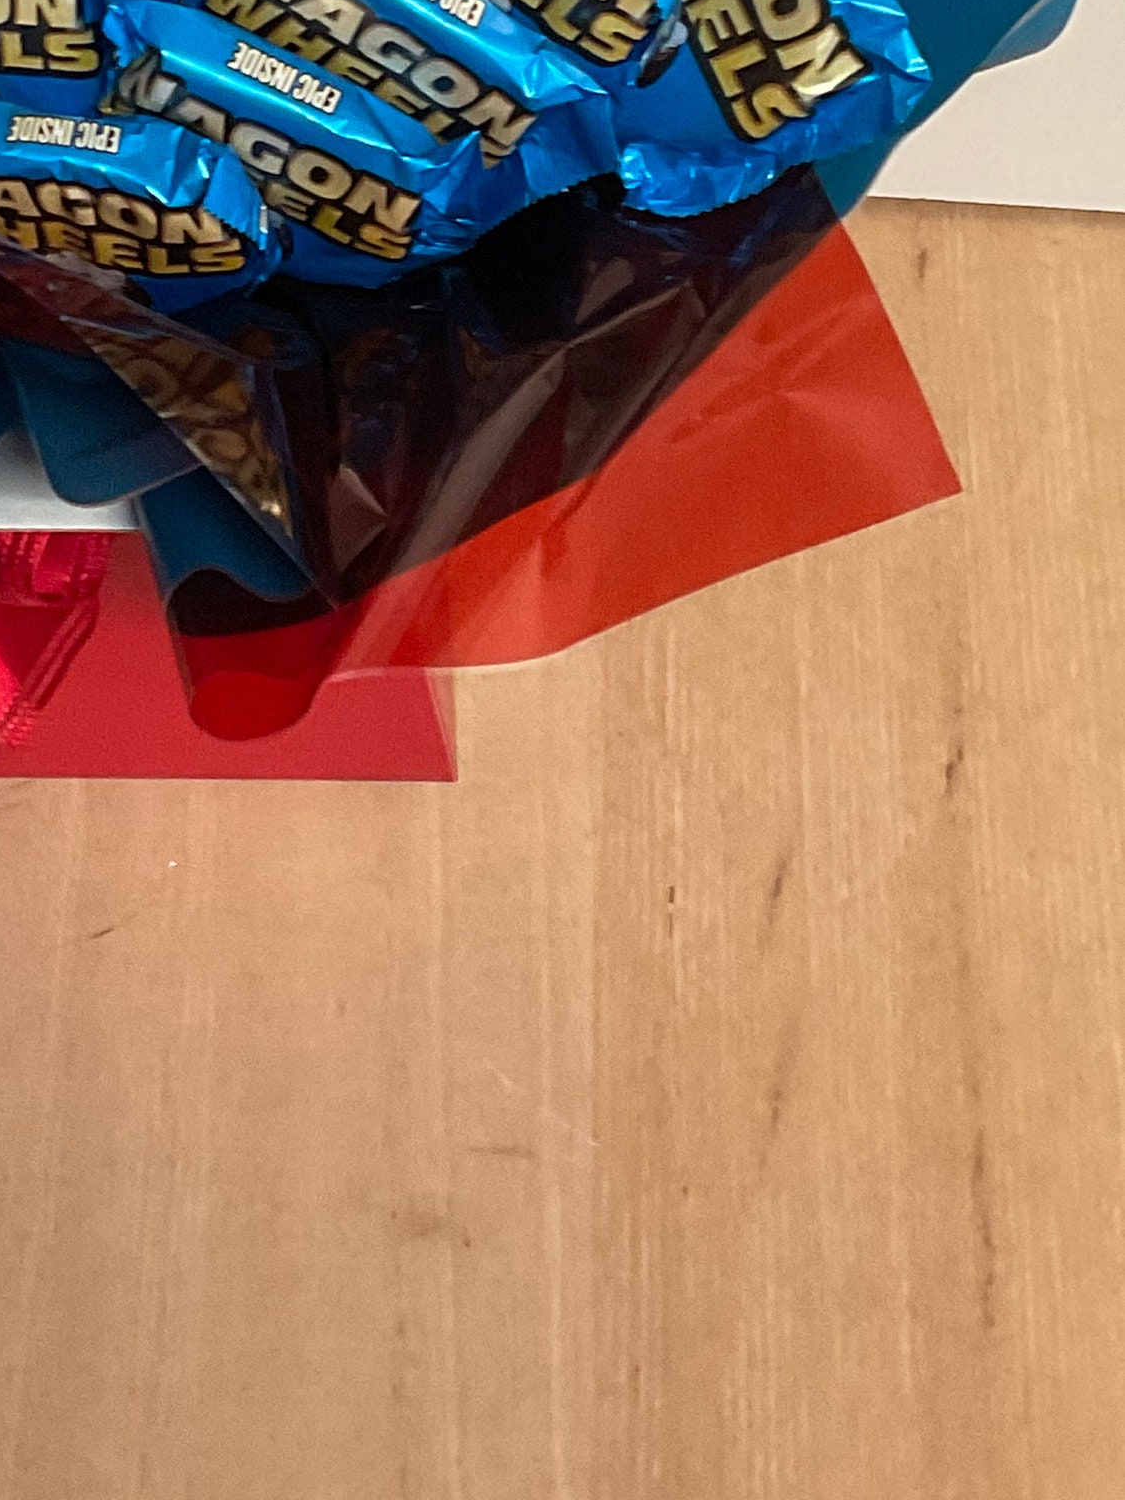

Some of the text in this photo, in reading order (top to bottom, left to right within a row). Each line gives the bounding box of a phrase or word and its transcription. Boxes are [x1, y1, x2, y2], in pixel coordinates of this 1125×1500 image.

[226, 43, 342, 114] EPIC INSIDE
[7, 115, 122, 154] EPIC INSIDE
